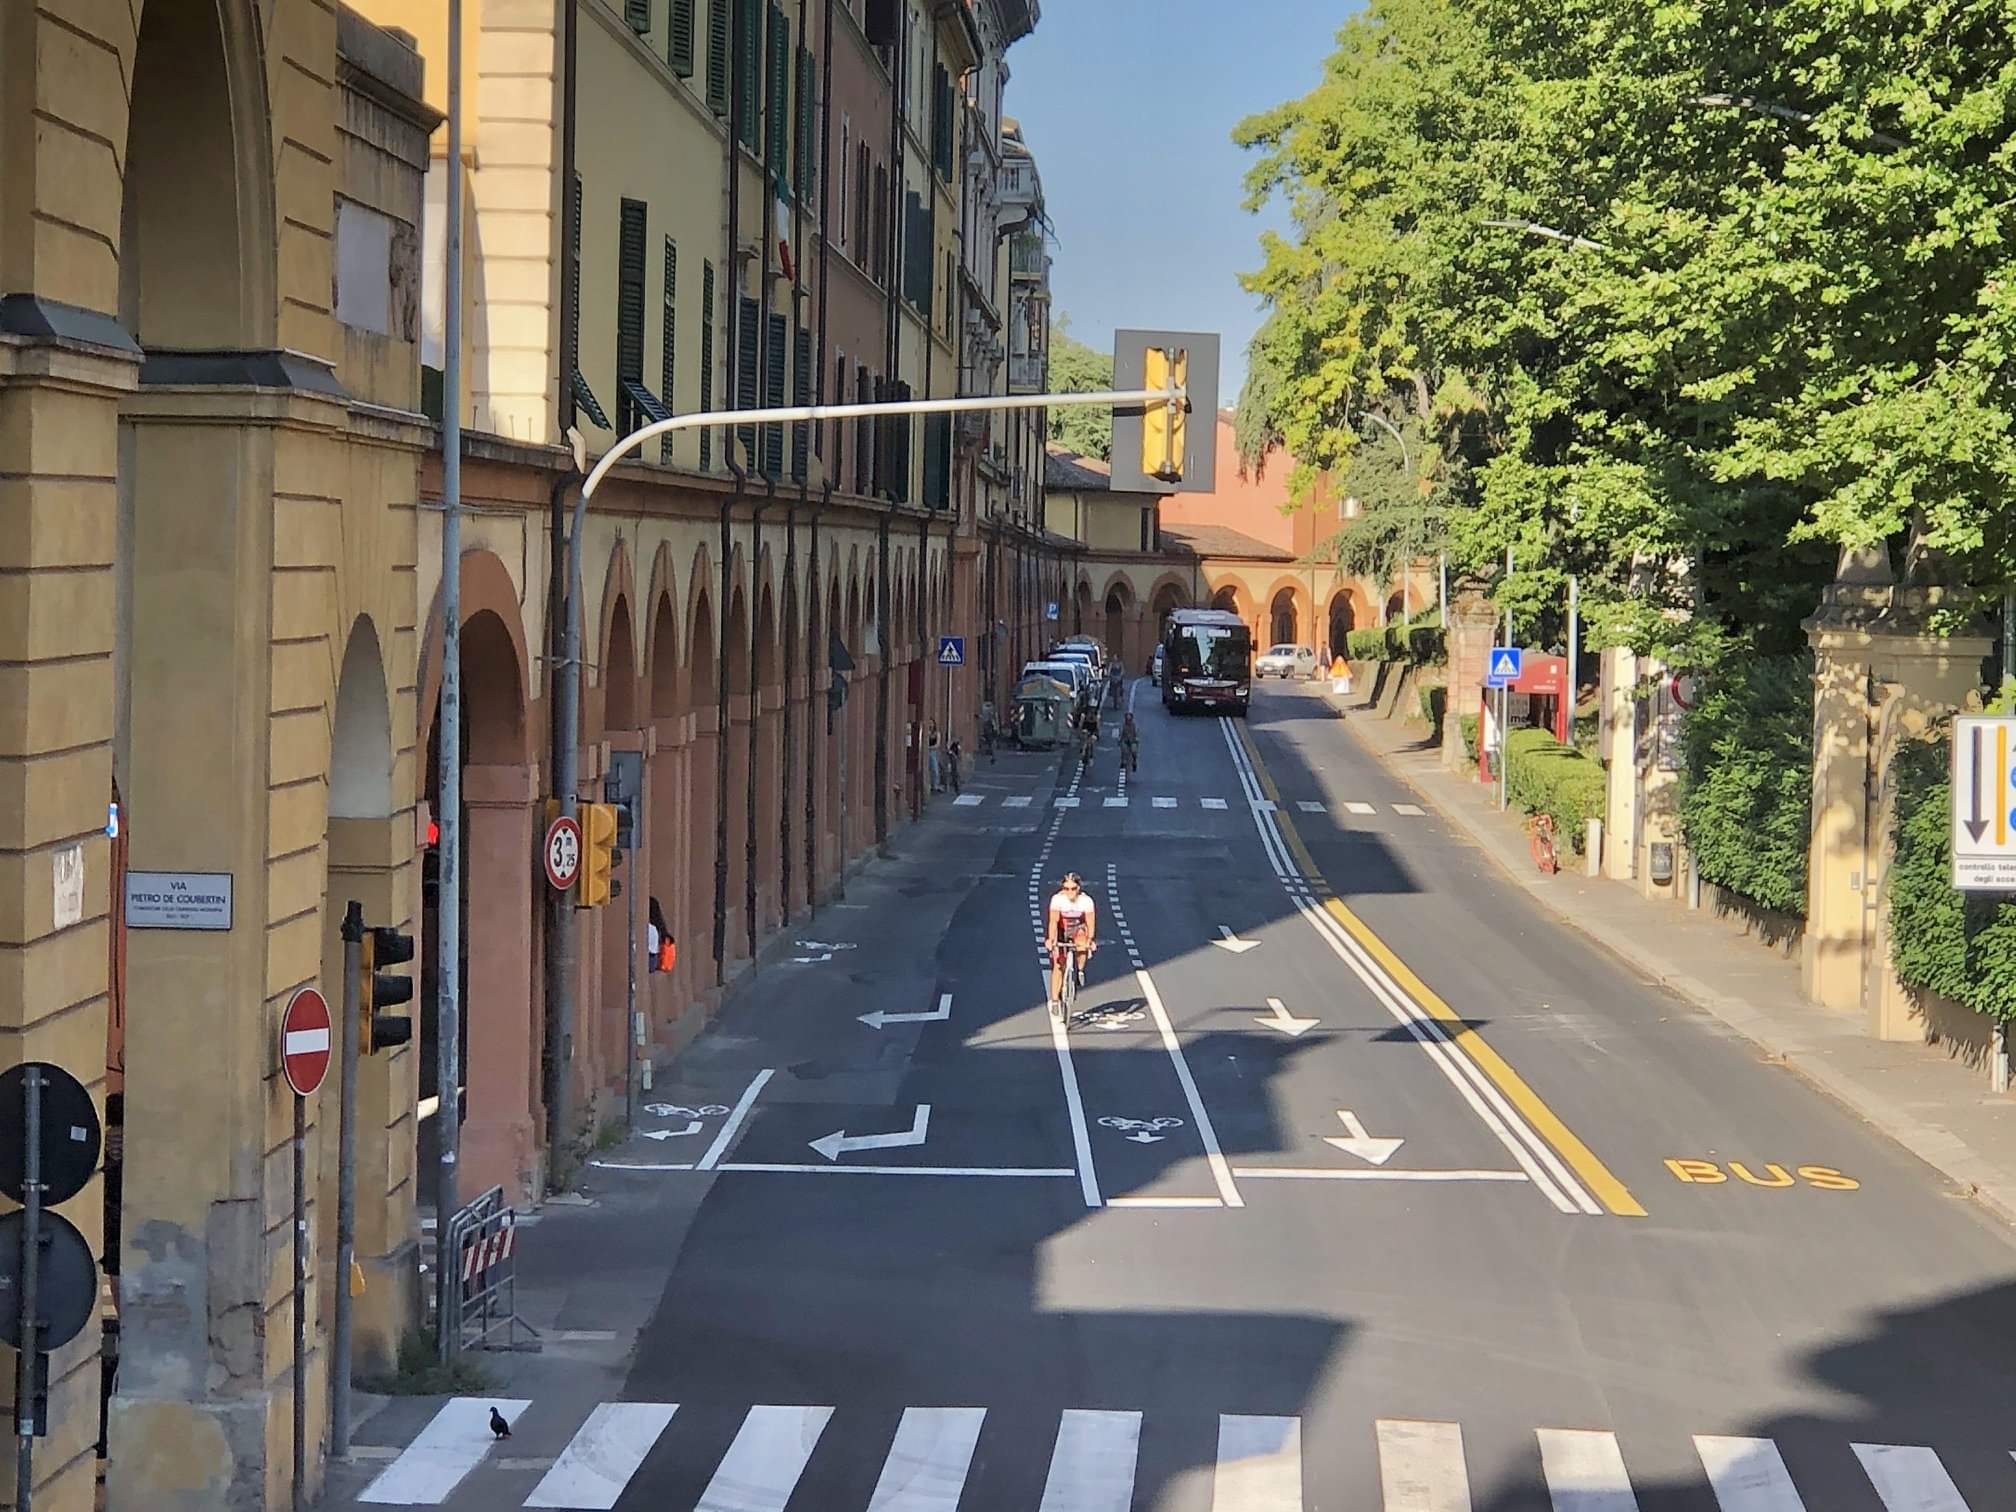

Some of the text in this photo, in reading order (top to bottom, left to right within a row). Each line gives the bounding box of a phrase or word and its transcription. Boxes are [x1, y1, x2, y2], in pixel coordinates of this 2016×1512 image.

[553, 837, 562, 867] 3
[170, 882, 187, 890] VIA
[131, 894, 226, 904] PIETRO DE COUBERTIN
[1663, 1159, 1860, 1190] BUS
